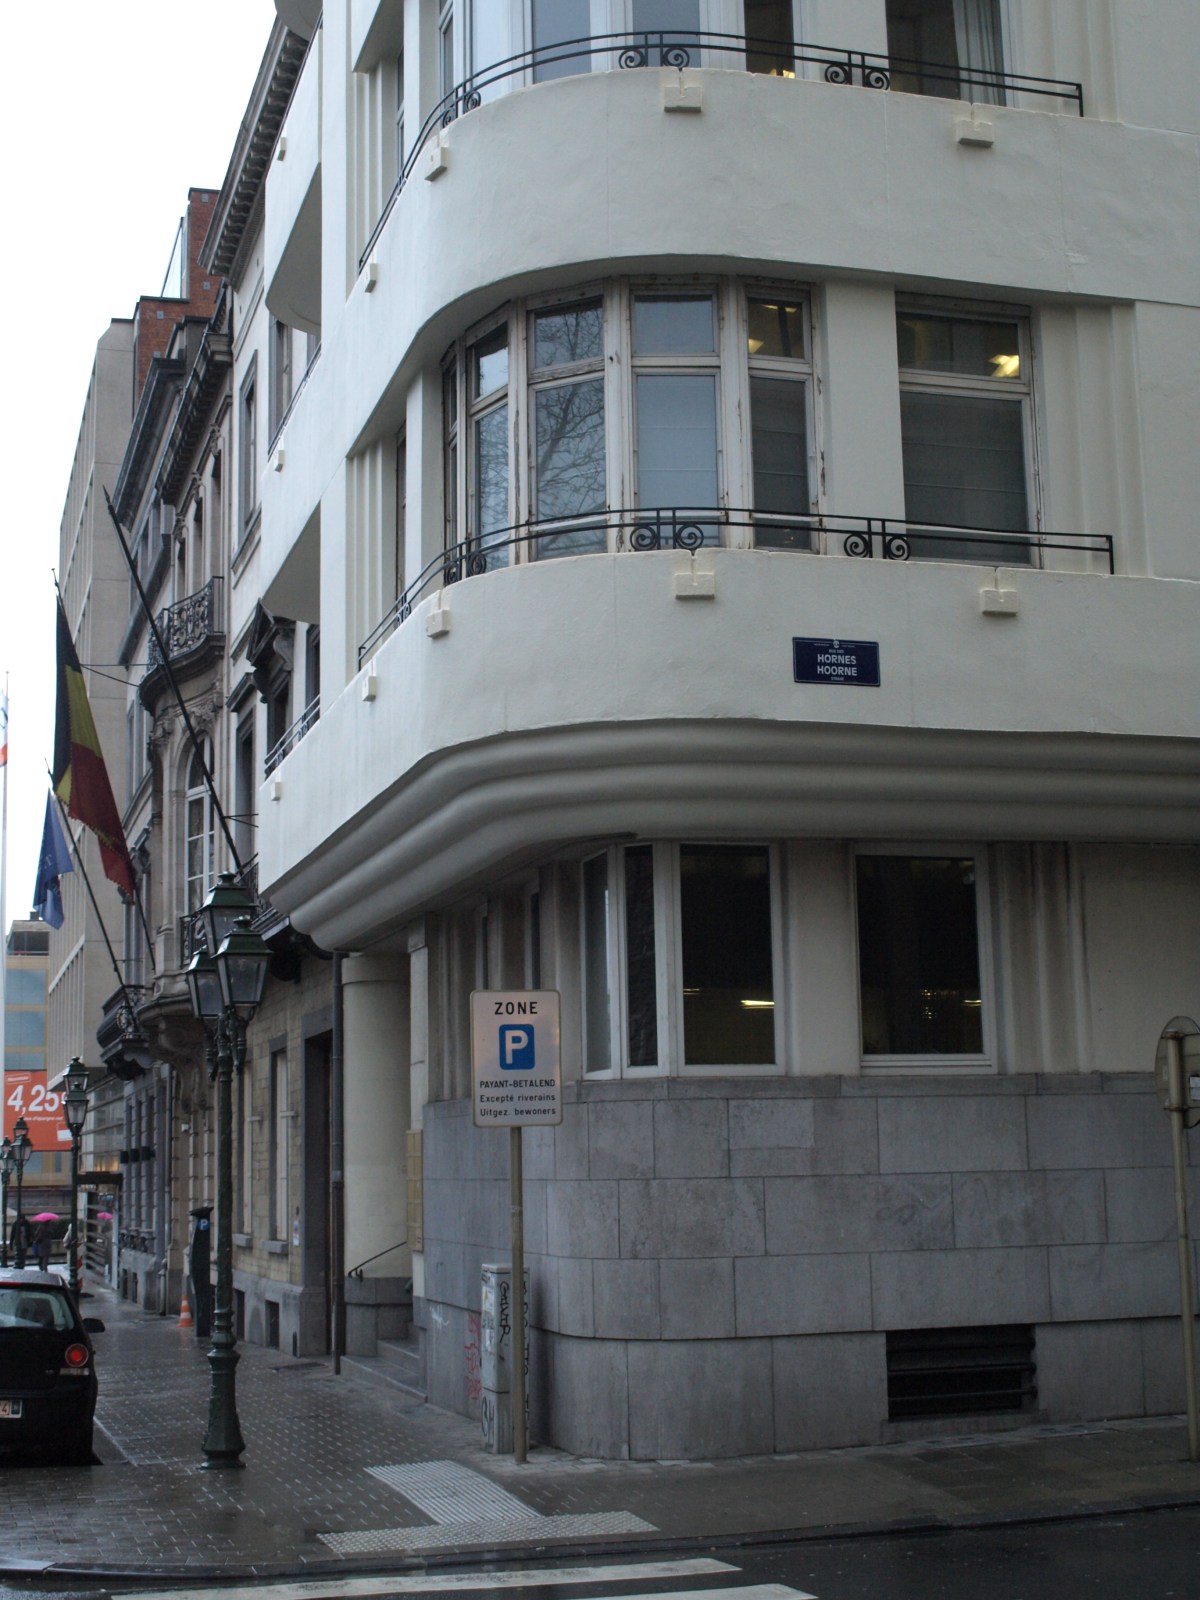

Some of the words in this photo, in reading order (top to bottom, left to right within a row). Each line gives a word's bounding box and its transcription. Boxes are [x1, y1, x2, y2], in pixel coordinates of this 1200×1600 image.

[817, 654, 856, 665] HORNES
[817, 665, 858, 676] HOORNE
[494, 1002, 538, 1015] ZONE
[505, 1030, 528, 1064] P
[480, 1079, 555, 1088] PAYANT-BETALEND
[480, 1094, 514, 1104] Excepté
[518, 1093, 556, 1102] riverains
[515, 1107, 556, 1116] bewoners
